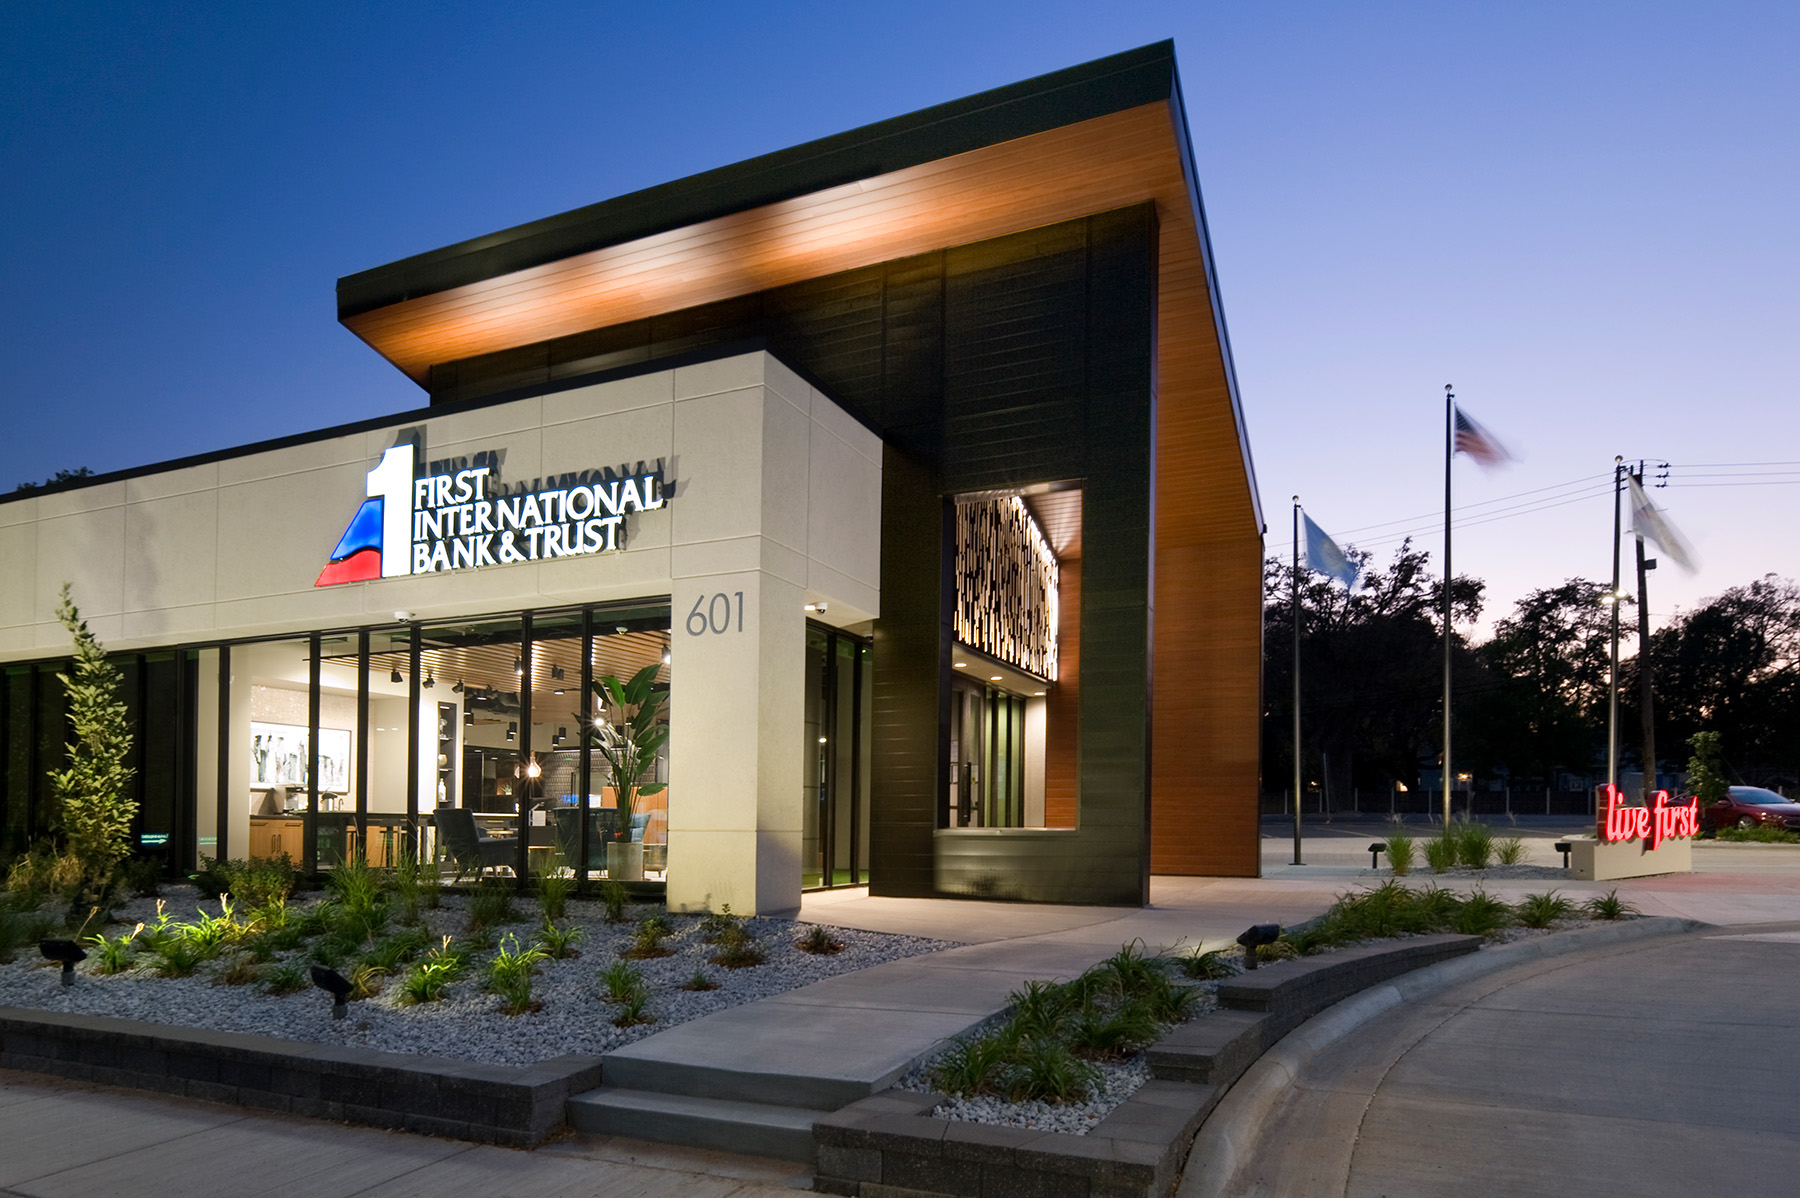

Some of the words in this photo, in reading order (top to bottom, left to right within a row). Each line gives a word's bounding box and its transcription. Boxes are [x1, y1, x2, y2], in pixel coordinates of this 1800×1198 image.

[367, 444, 414, 578] 1
[413, 475, 664, 542] INTERNATIONAL
[414, 467, 491, 510] FIRST
[412, 533, 498, 575] BANK
[499, 530, 528, 564] &
[524, 516, 623, 560] TRUST
[686, 591, 744, 637] 601
[1606, 783, 1651, 842] live
[1652, 789, 1700, 851] first
